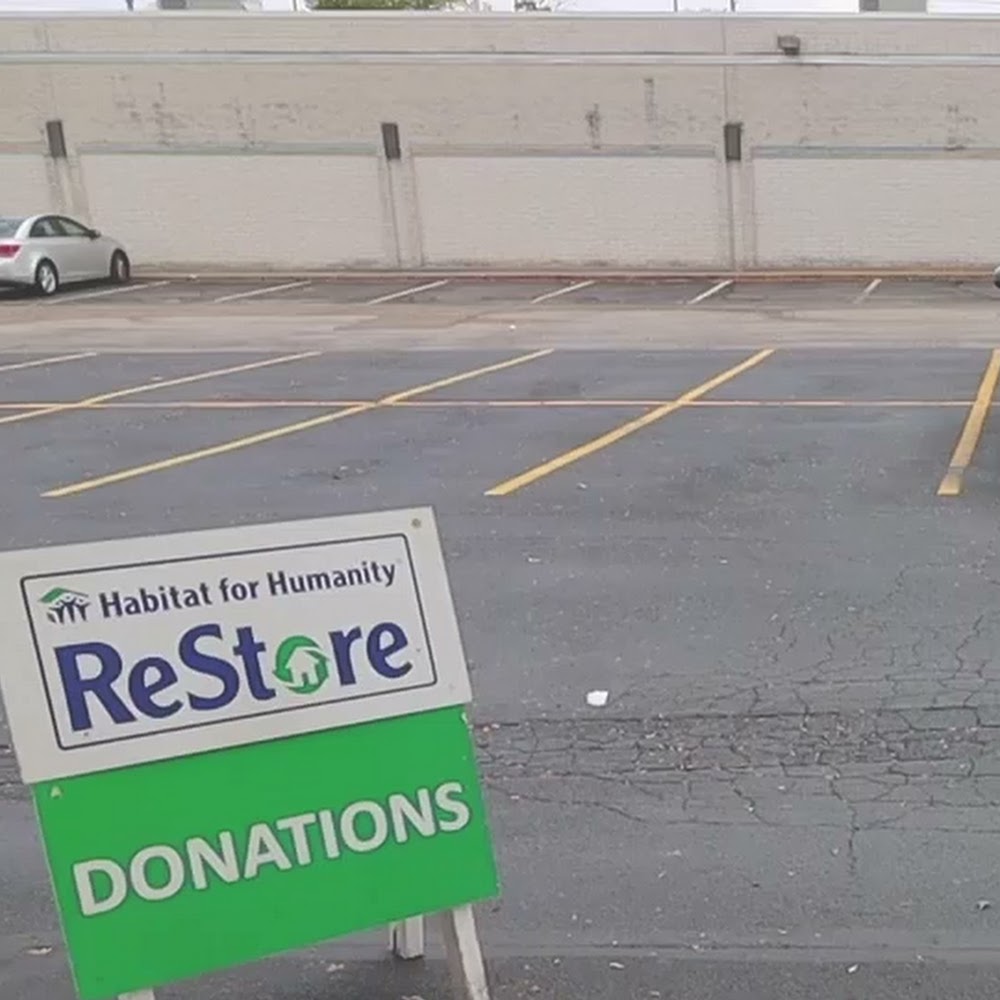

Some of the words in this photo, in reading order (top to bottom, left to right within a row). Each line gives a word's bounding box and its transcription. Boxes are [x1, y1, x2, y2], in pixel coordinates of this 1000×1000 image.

[99, 582, 213, 618] Habitat
[219, 577, 260, 602] for
[267, 560, 396, 597] Humanity
[54, 621, 413, 732] ReStore
[72, 781, 471, 917] DONATIONS
